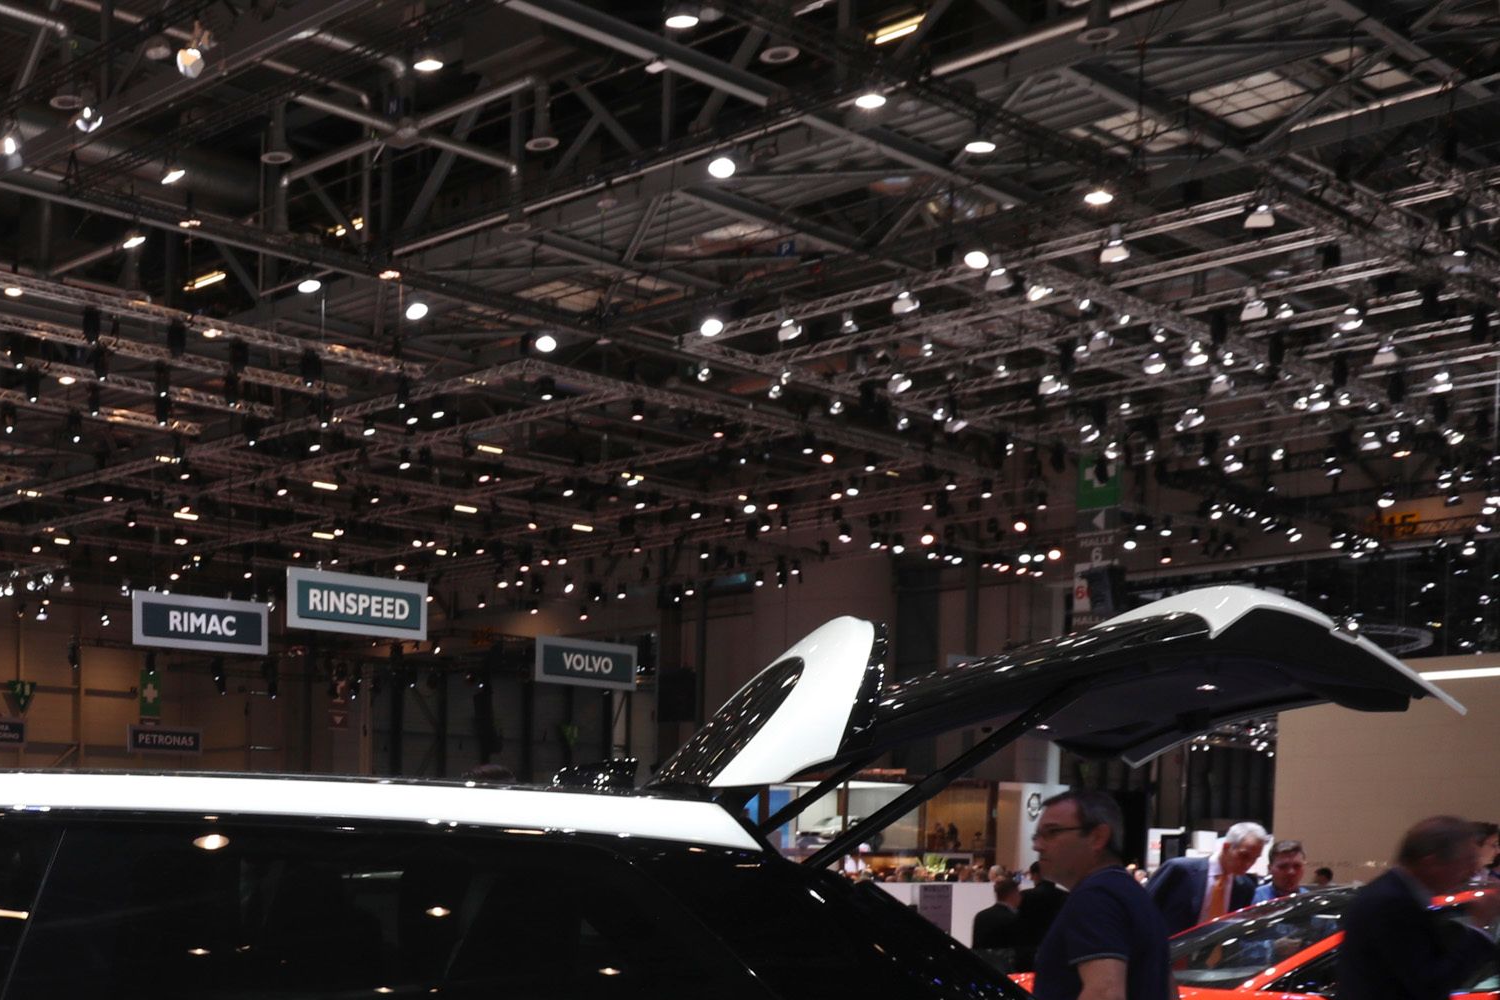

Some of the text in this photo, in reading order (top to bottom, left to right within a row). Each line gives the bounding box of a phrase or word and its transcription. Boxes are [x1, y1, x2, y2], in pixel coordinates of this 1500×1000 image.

[309, 588, 410, 621] RINSPEED
[169, 610, 237, 637] RIMAC
[562, 651, 613, 674] VOLVO
[138, 733, 195, 746] PETRONAS
